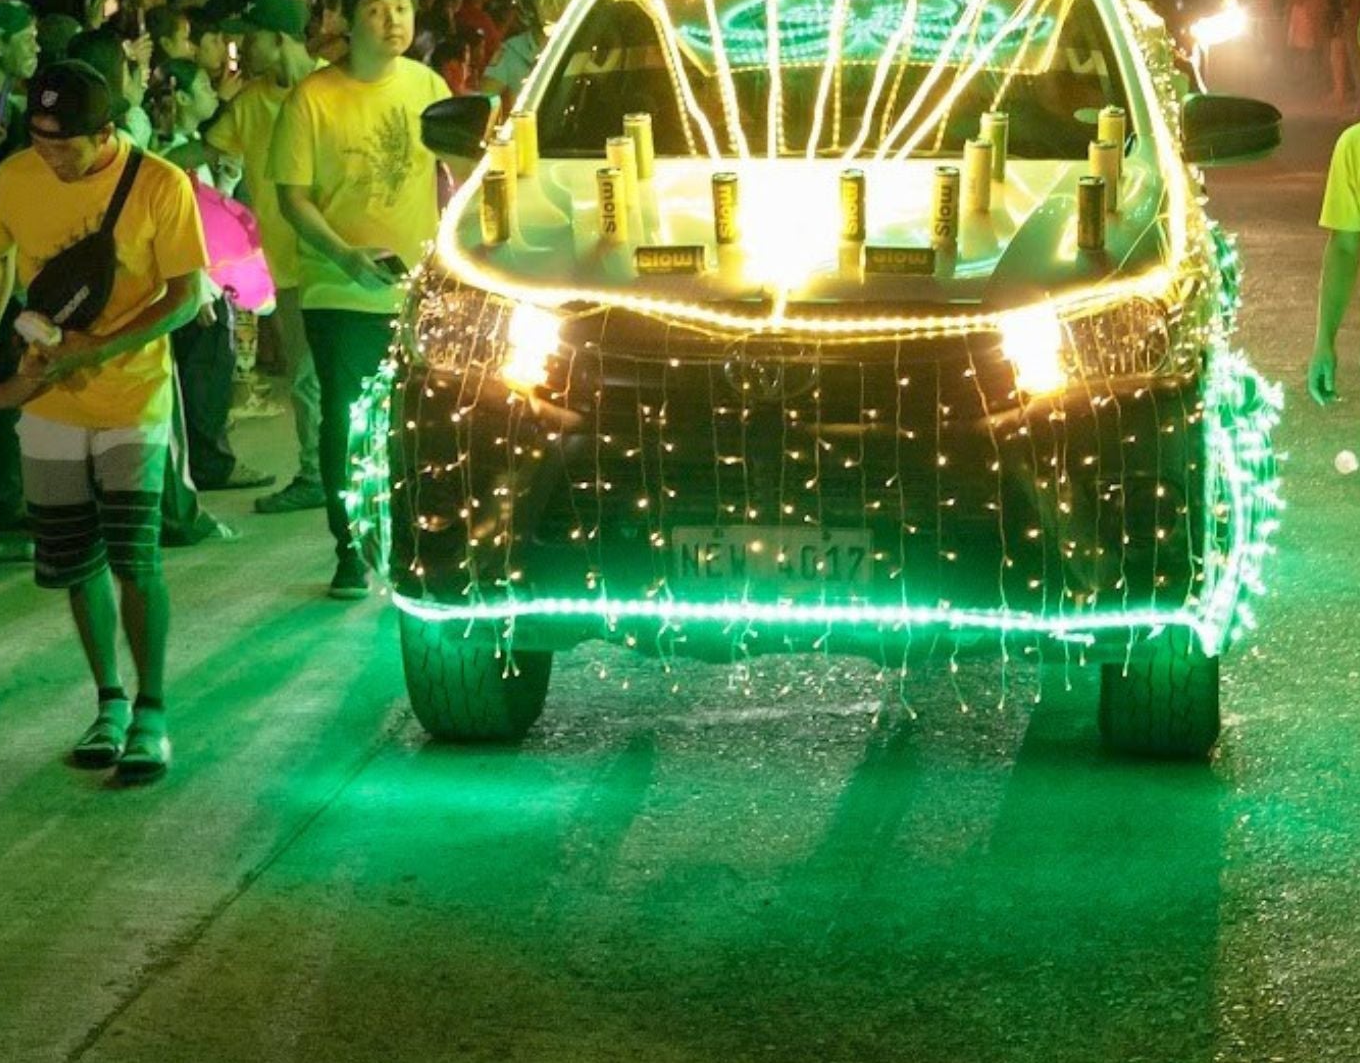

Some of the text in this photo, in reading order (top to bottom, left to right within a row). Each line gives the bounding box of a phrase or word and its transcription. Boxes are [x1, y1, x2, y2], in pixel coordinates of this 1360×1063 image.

[601, 181, 618, 234] Slow
[716, 184, 733, 239] Slow
[842, 181, 859, 236] Slow
[934, 183, 953, 237] Slow
[638, 249, 694, 268] Slow
